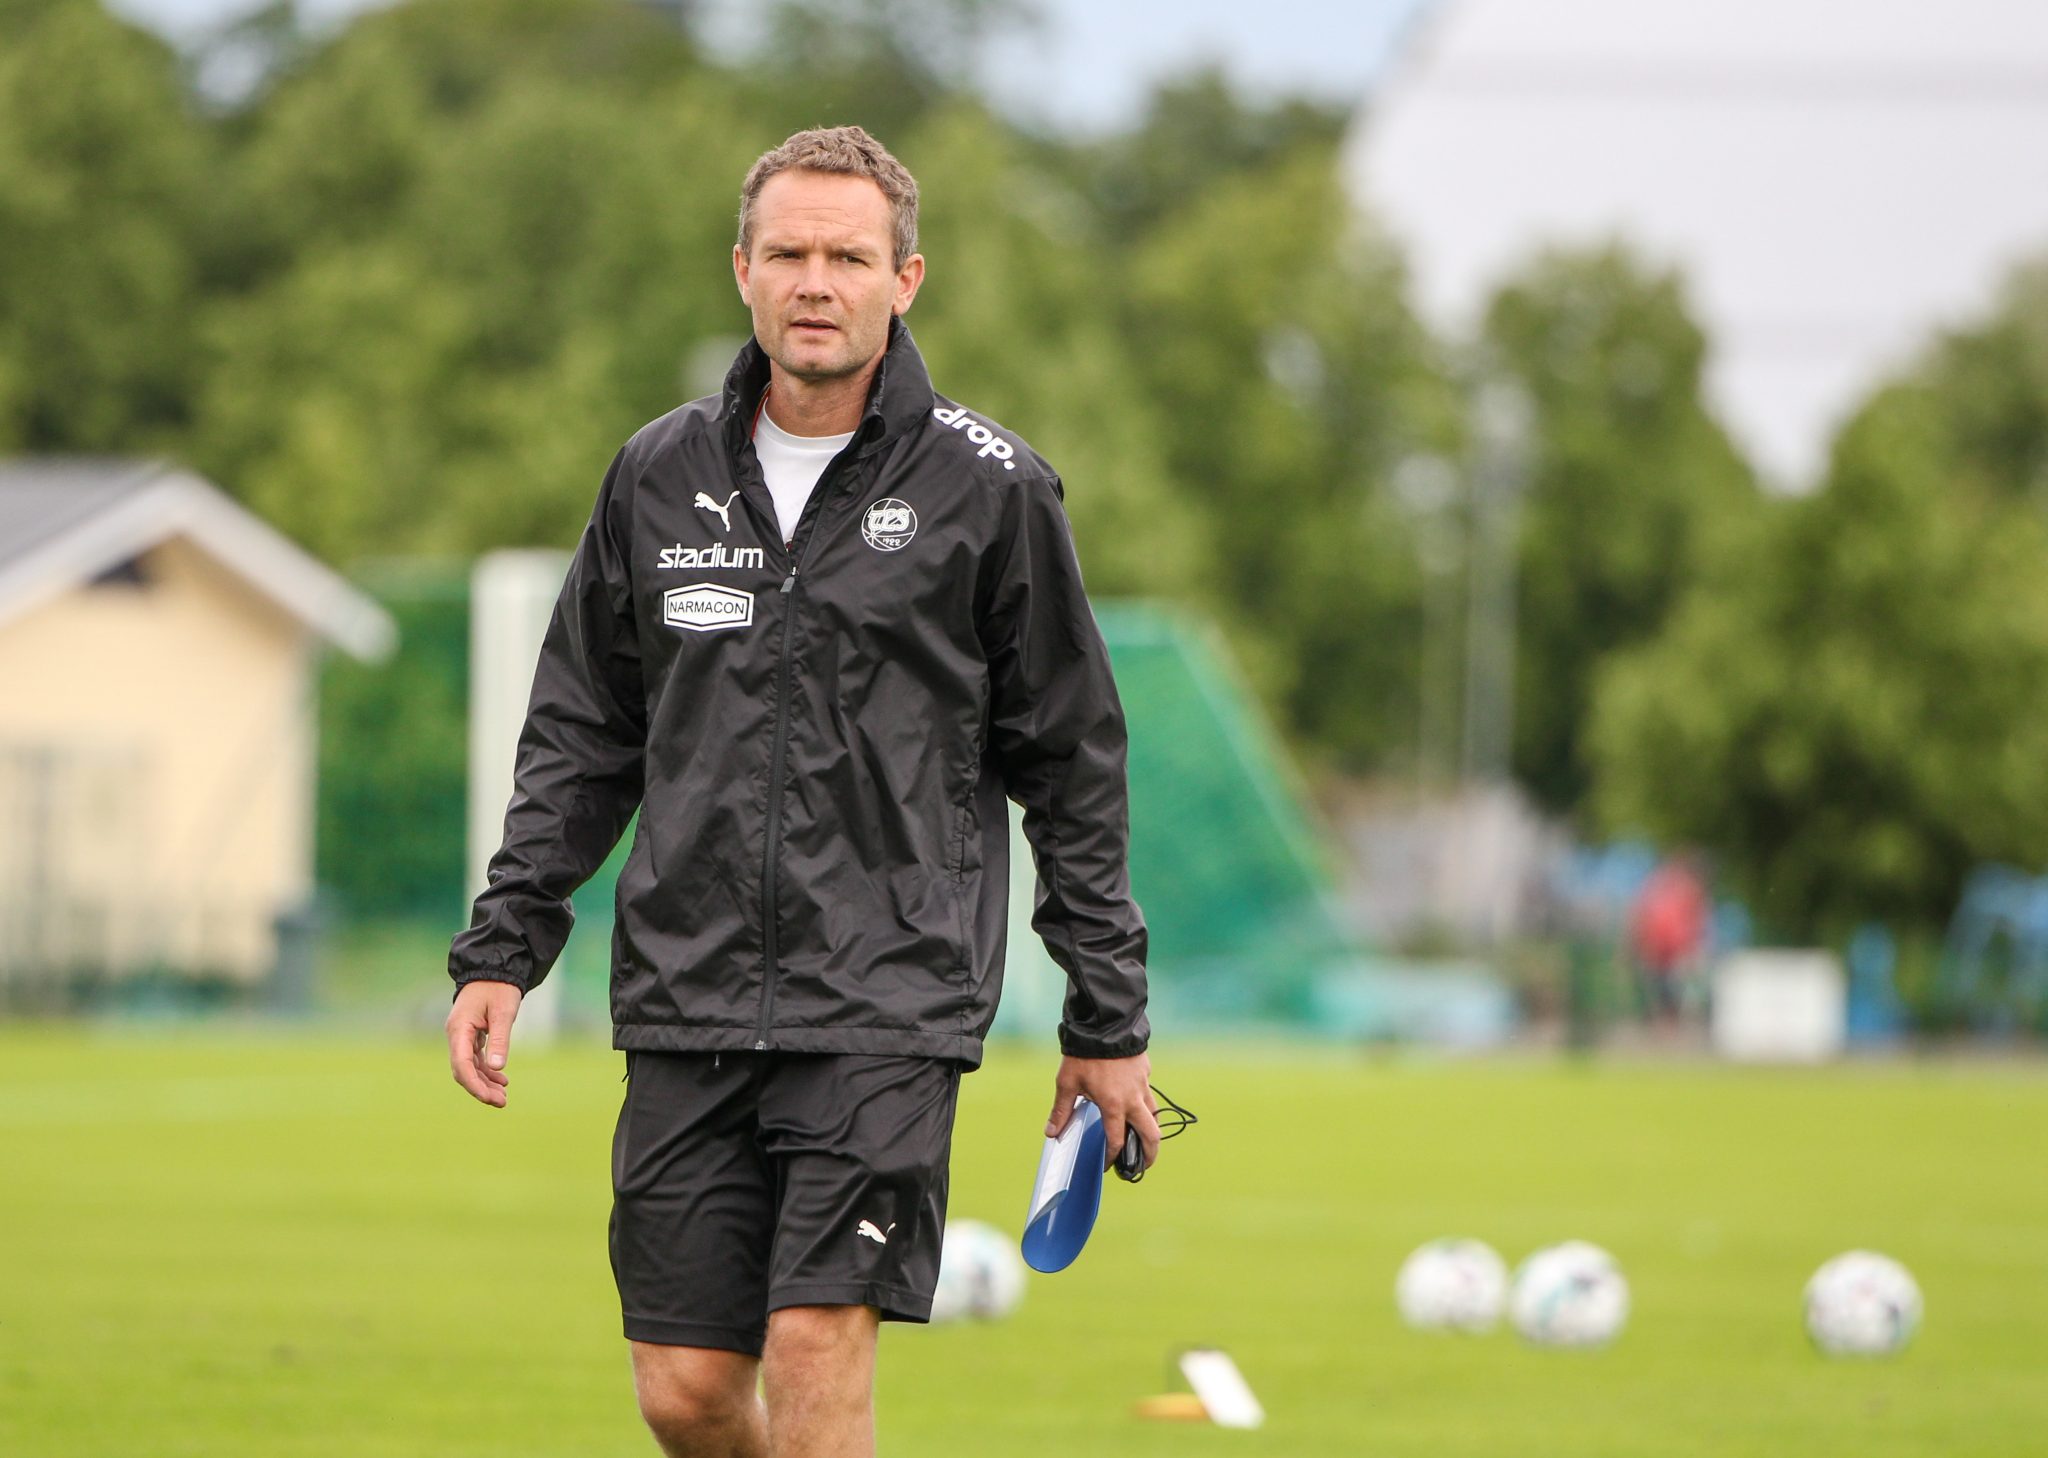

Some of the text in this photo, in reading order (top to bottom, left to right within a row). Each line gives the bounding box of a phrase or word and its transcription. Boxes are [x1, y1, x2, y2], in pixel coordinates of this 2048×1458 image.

[933, 408, 1016, 470] drop.
[882, 537, 901, 546] 1922
[657, 542, 764, 569] stadium
[669, 601, 745, 615] NARMACON
